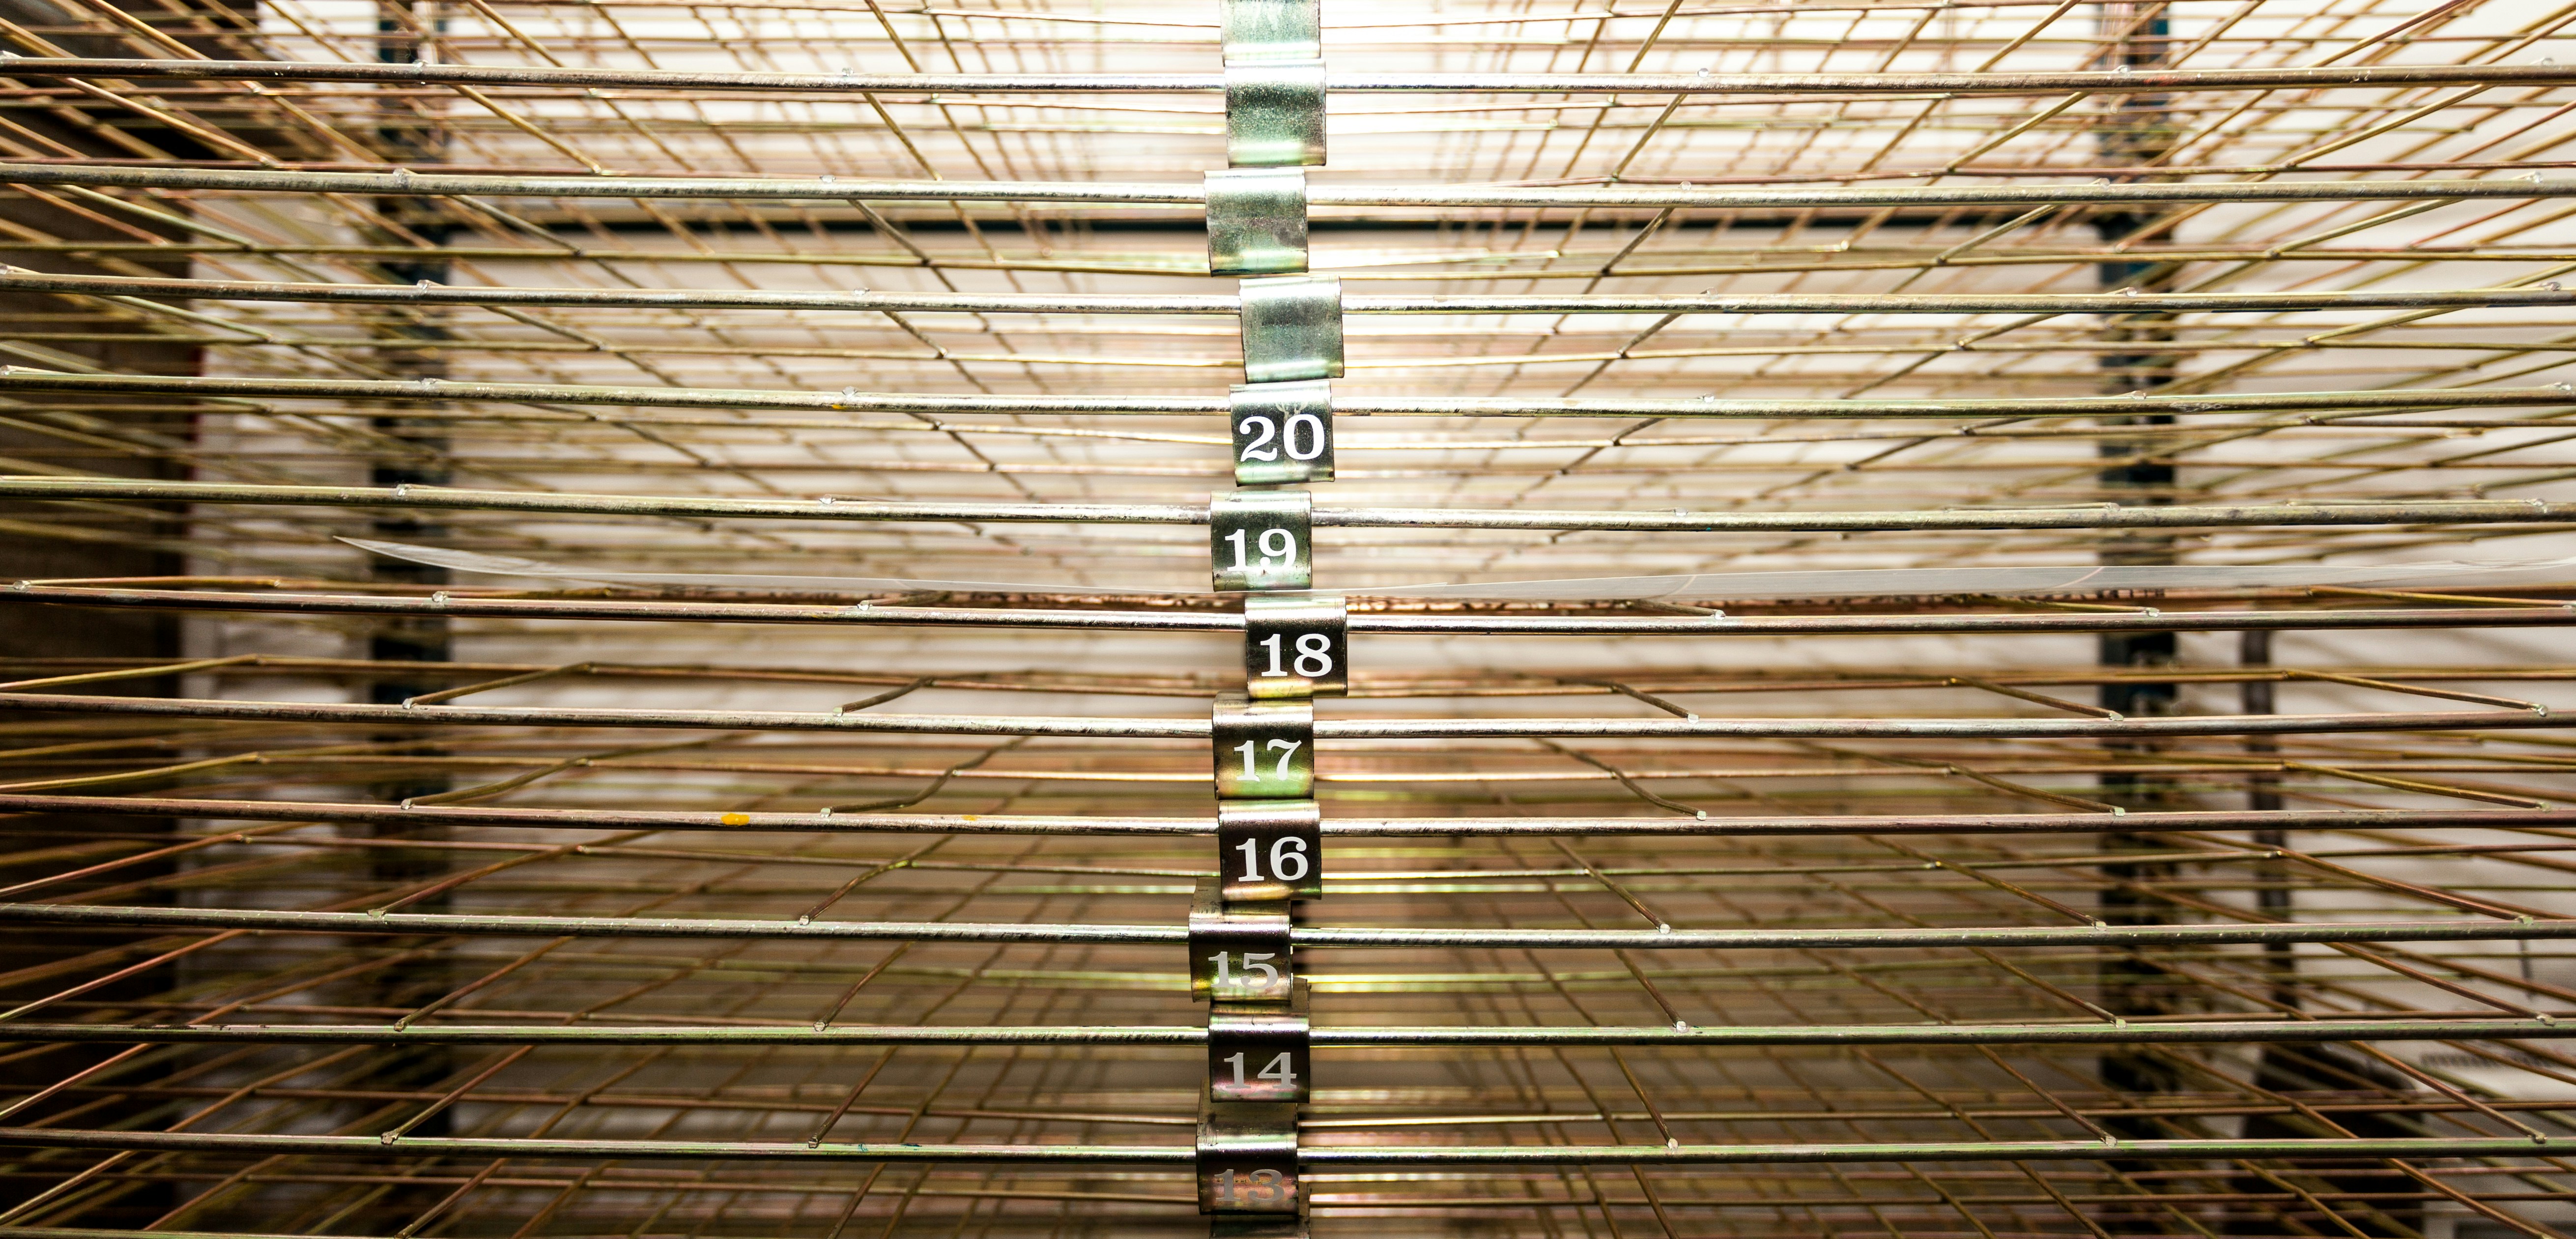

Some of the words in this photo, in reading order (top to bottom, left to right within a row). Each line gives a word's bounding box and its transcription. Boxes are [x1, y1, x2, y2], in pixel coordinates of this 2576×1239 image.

[1239, 414, 1325, 461] 20
[1225, 528, 1297, 572] 19
[1260, 634, 1332, 677] 18
[1234, 739, 1302, 782] 17
[1236, 836, 1308, 882] 16
[1208, 951, 1278, 990] 15
[1224, 1052, 1297, 1089] 14
[1214, 1169, 1285, 1203] 13
